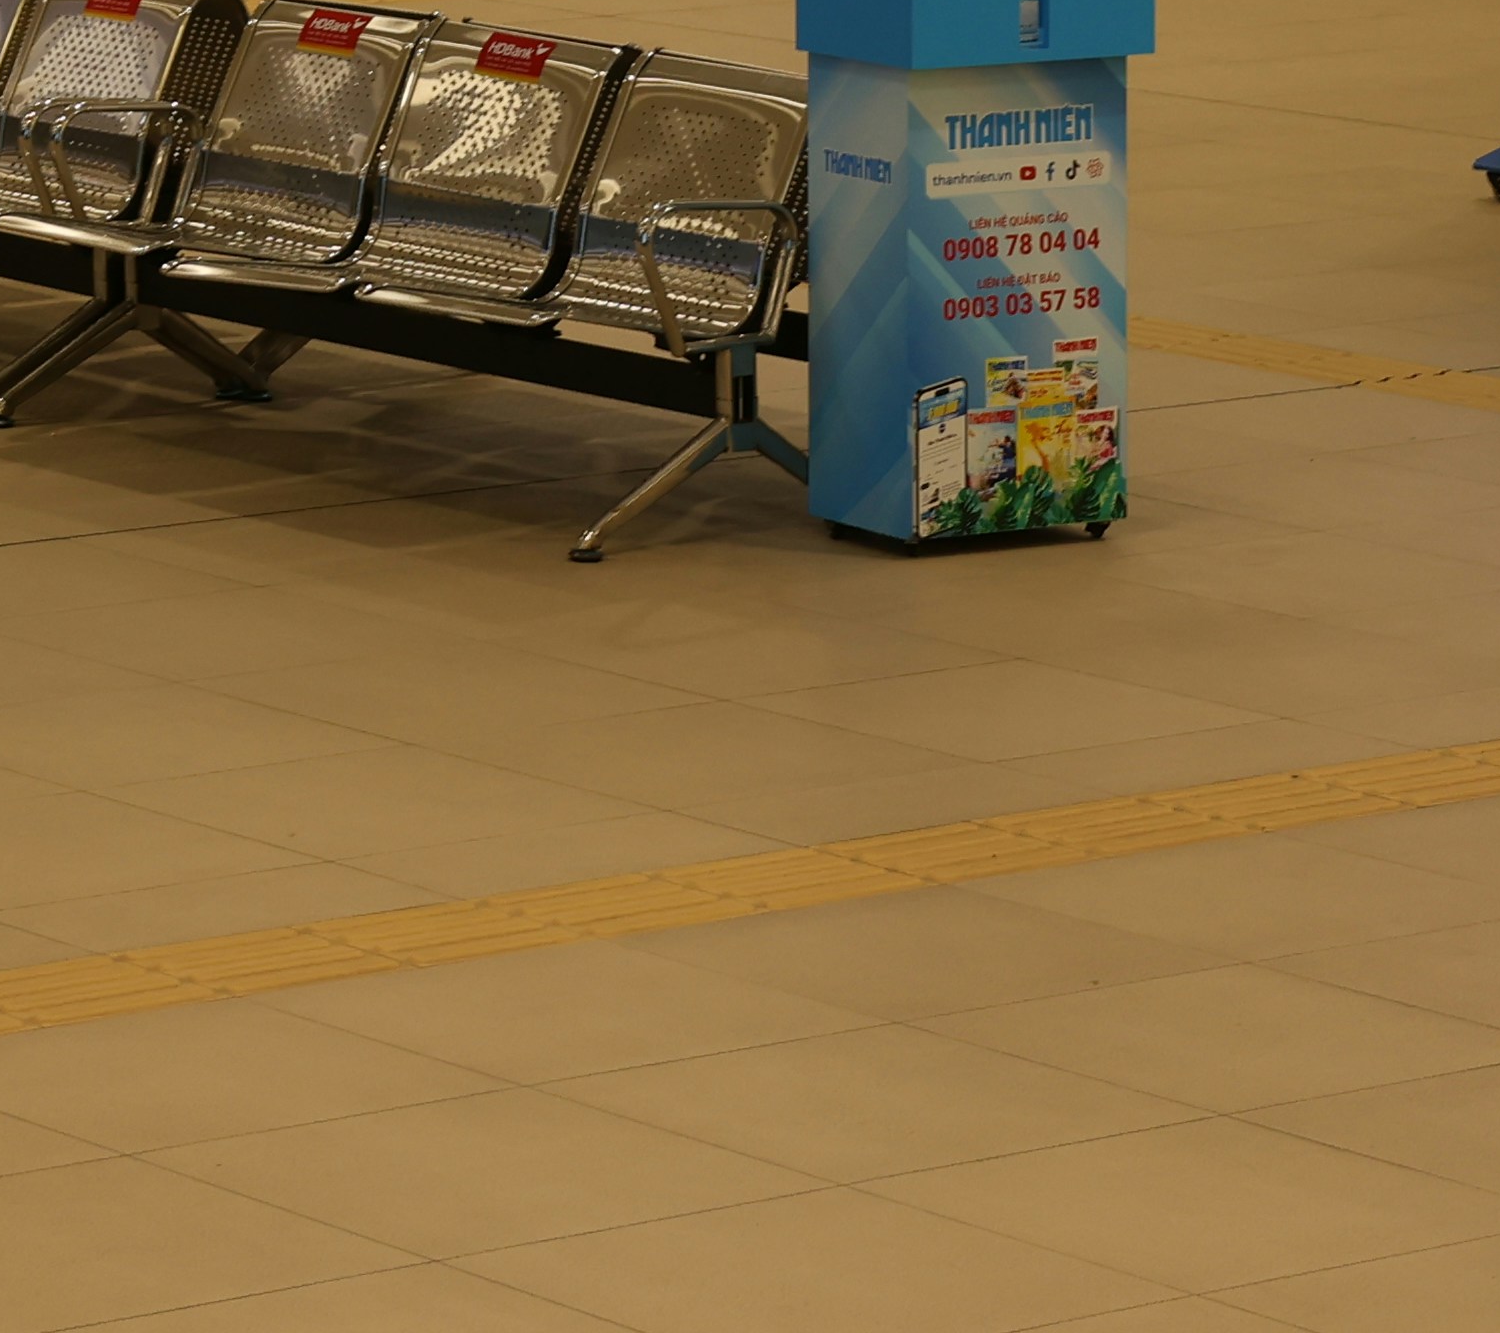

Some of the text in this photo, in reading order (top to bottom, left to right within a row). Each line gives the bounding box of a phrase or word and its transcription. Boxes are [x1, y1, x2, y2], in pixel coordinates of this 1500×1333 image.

[310, 17, 352, 33] HDBank
[488, 41, 534, 59] HDBank
[945, 103, 1093, 150] THANH NIÊN
[824, 149, 863, 179] THANH
[933, 170, 1012, 186] thanhnien.vn
[969, 215, 991, 230] LIÊN
[1010, 212, 1045, 226] QUẢNG
[1047, 211, 1069, 224] CÁO
[943, 228, 1101, 261] 0908 78 04 04
[977, 276, 1000, 289] LIÊN
[1040, 272, 1060, 284] BÁO
[943, 286, 1100, 320] 0903 03 57 58
